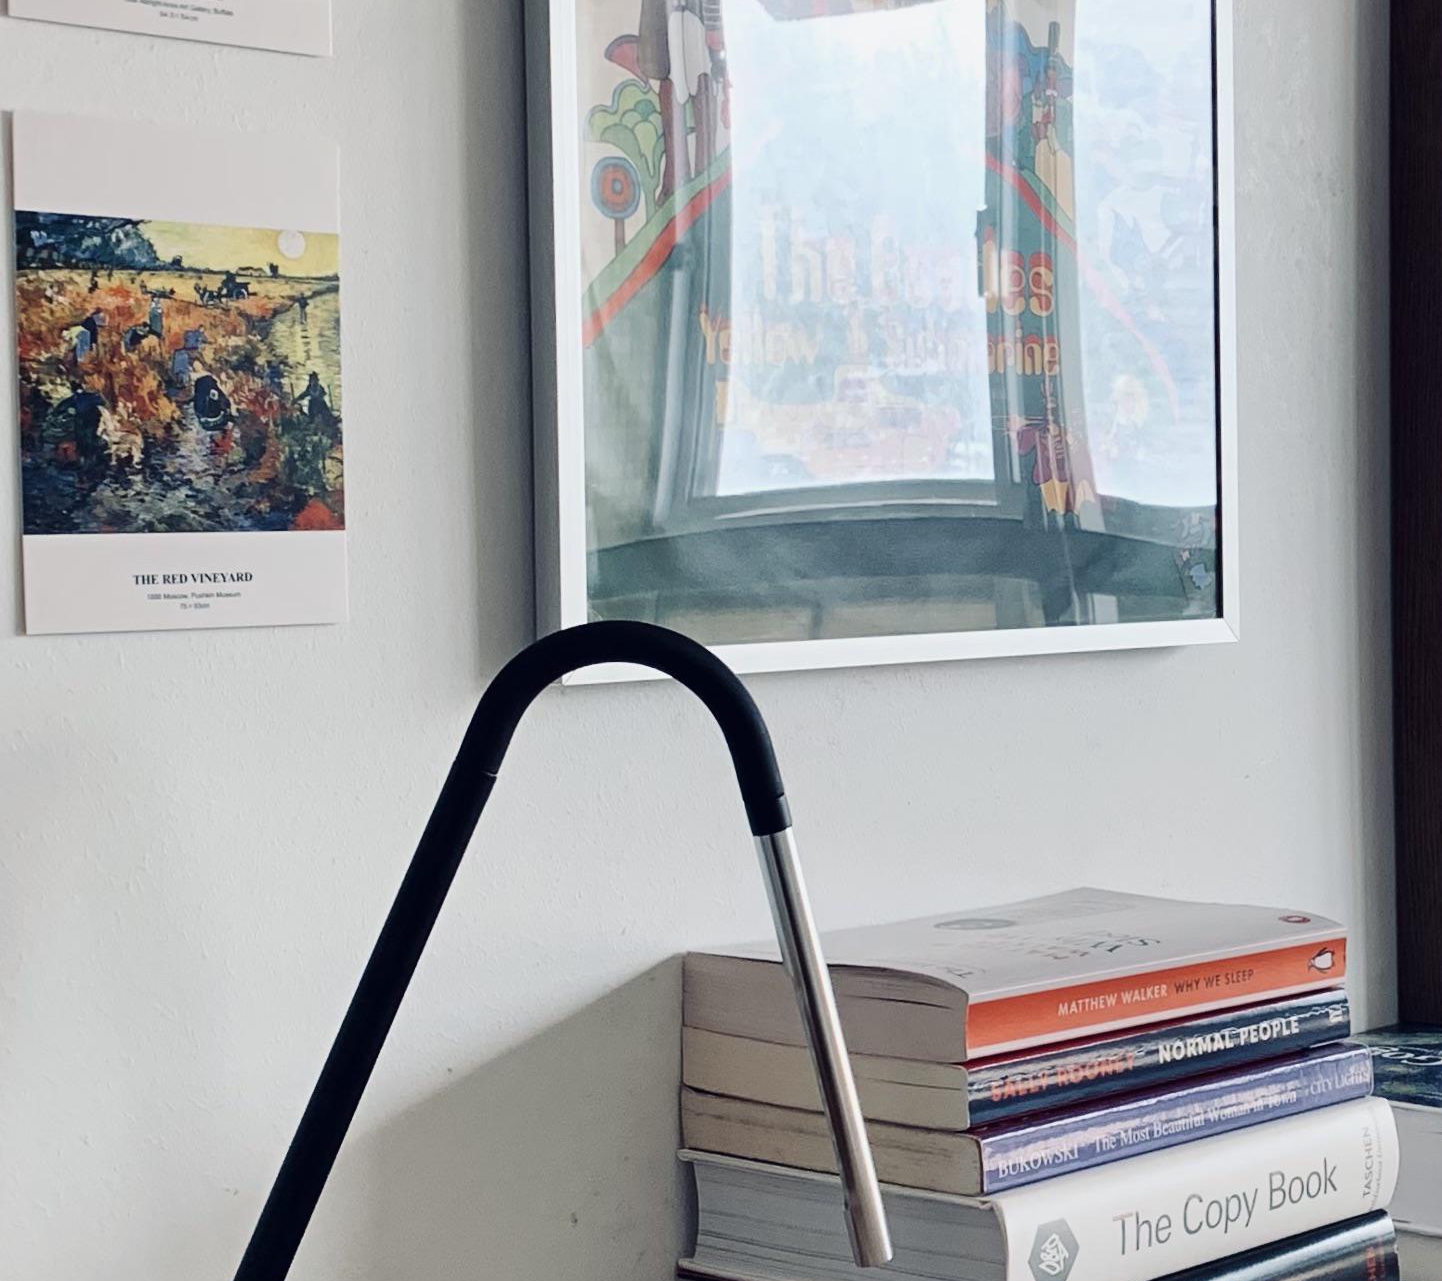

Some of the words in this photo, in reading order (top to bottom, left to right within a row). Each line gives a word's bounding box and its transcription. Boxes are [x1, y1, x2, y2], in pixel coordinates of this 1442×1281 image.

[758, 204, 856, 303] The
[870, 214, 1055, 318] Beales
[699, 306, 823, 367] Yellow
[132, 574, 159, 586] THE
[162, 573, 188, 585] RED
[190, 571, 253, 584] VINEYARD
[1057, 992, 1118, 1017] MATTHEW
[1121, 983, 1168, 1004] WALKER
[1174, 977, 1201, 995] WHY
[1203, 973, 1221, 989] WE
[1224, 968, 1255, 987] SLEEP
[990, 1072, 1049, 1102] SALLY
[1157, 1028, 1238, 1065] NORMAL
[1238, 1015, 1301, 1046] PEOPLE
[998, 1145, 1080, 1179] BUKOWSKI
[1093, 1135, 1117, 1154] The
[1119, 1126, 1151, 1147] Most
[1153, 1110, 1206, 1139] Beautiful
[1207, 1102, 1250, 1124] Woman
[1264, 1088, 1298, 1110] Town
[1361, 1124, 1375, 1199] TASCHEN
[1112, 1210, 1173, 1256] The
[1182, 1188, 1260, 1241] Copy
[1268, 1157, 1339, 1210] Book
